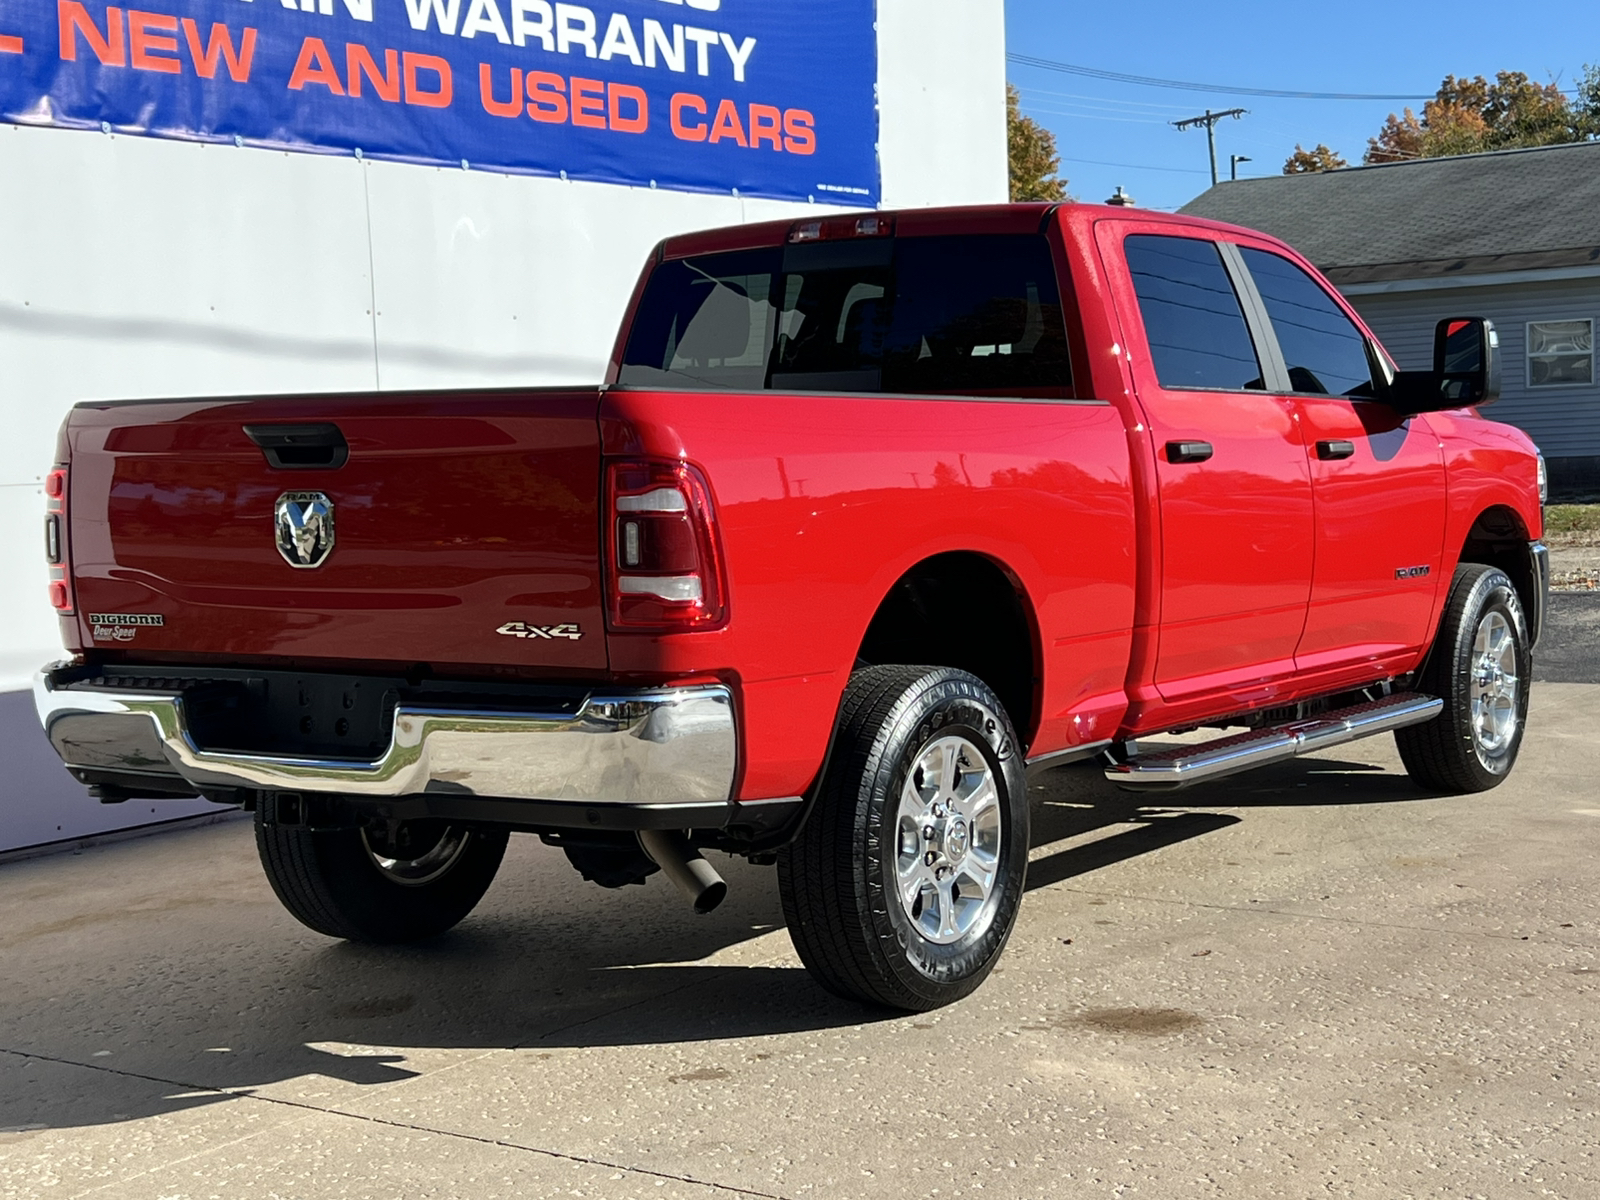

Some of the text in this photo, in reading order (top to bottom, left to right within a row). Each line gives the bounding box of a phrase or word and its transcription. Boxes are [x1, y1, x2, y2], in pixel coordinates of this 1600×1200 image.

[58, 0, 815, 155] NEW AND USED CARS
[402, 0, 756, 82] WARRANTY
[89, 613, 164, 626] BIGHORN
